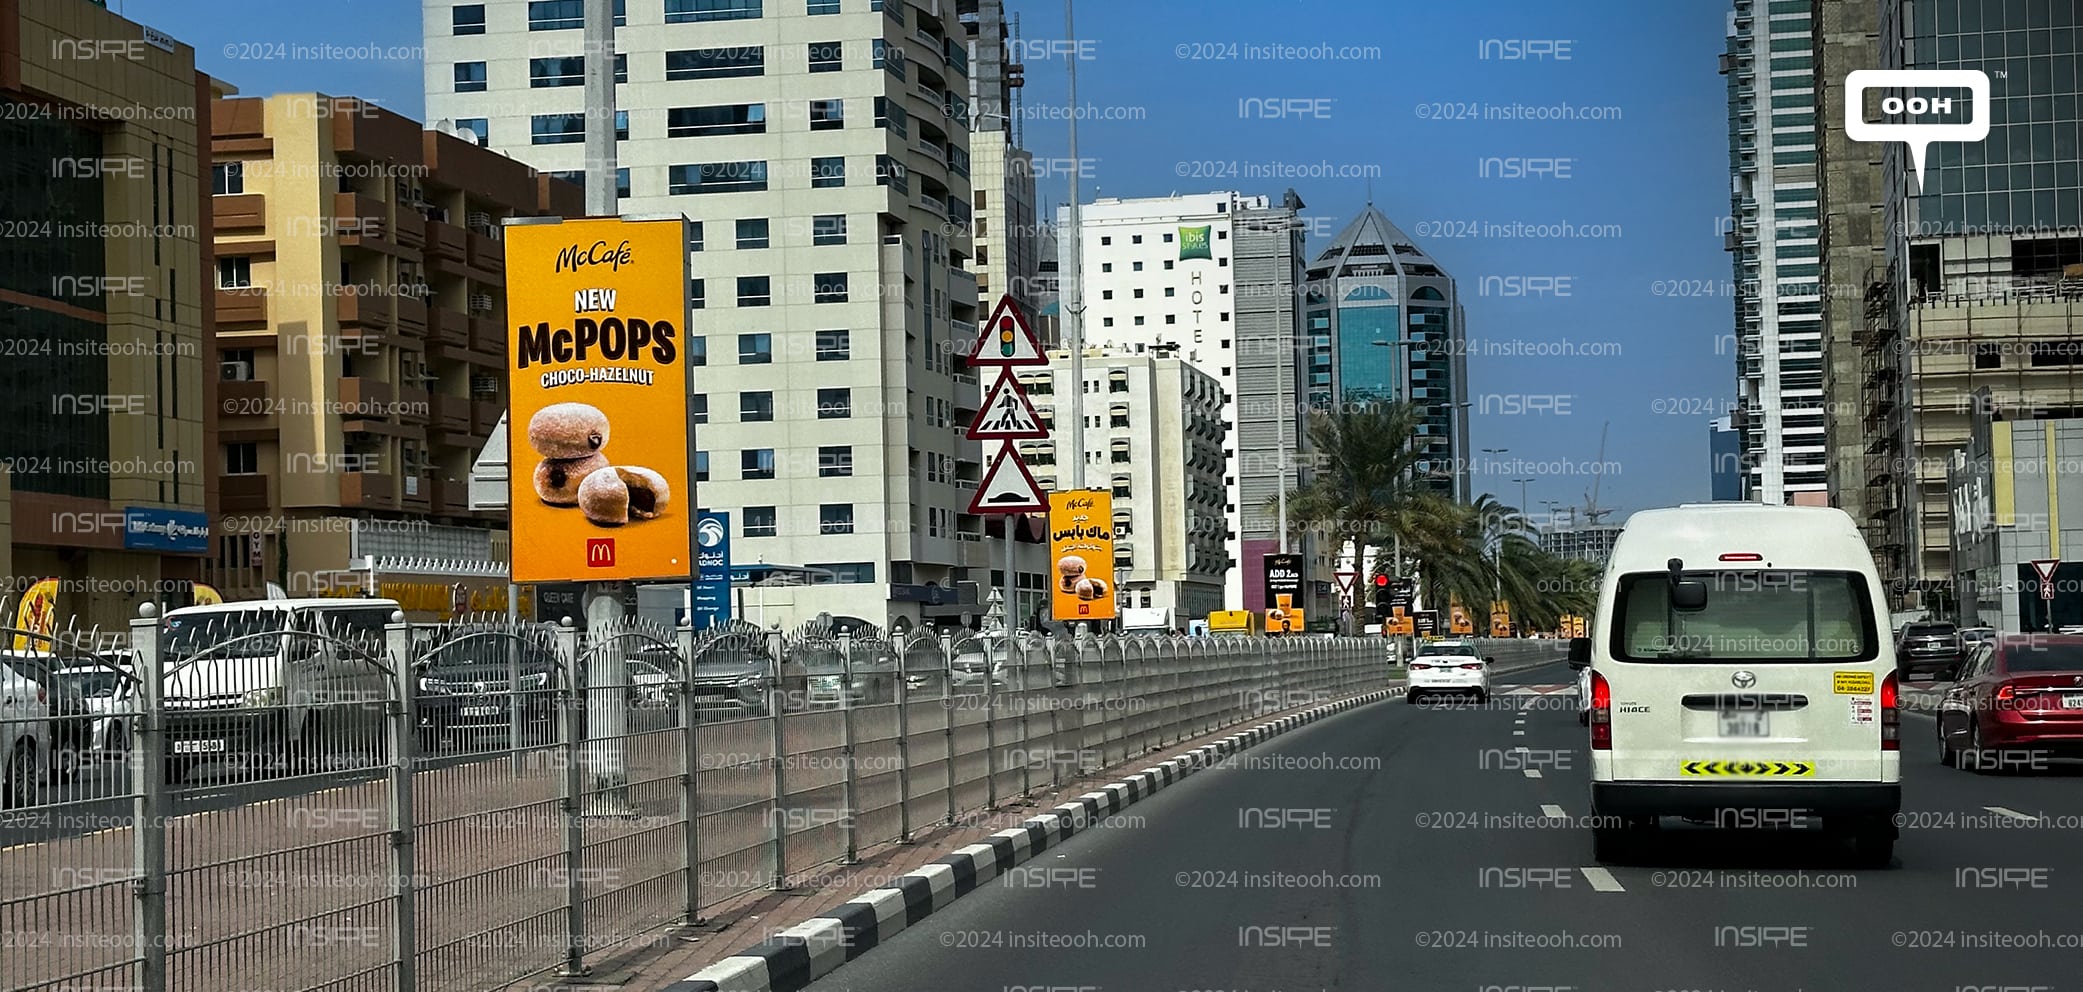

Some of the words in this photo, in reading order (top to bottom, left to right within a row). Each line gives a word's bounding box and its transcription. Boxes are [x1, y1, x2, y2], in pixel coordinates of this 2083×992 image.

[1185, 231, 1205, 243] ibis
[556, 240, 632, 273] McCafé
[574, 288, 616, 312] NEW
[518, 317, 676, 369] McPOPS
[540, 367, 654, 388] CHOCO-HAZELNUT
[1269, 569, 1285, 578] ADD
